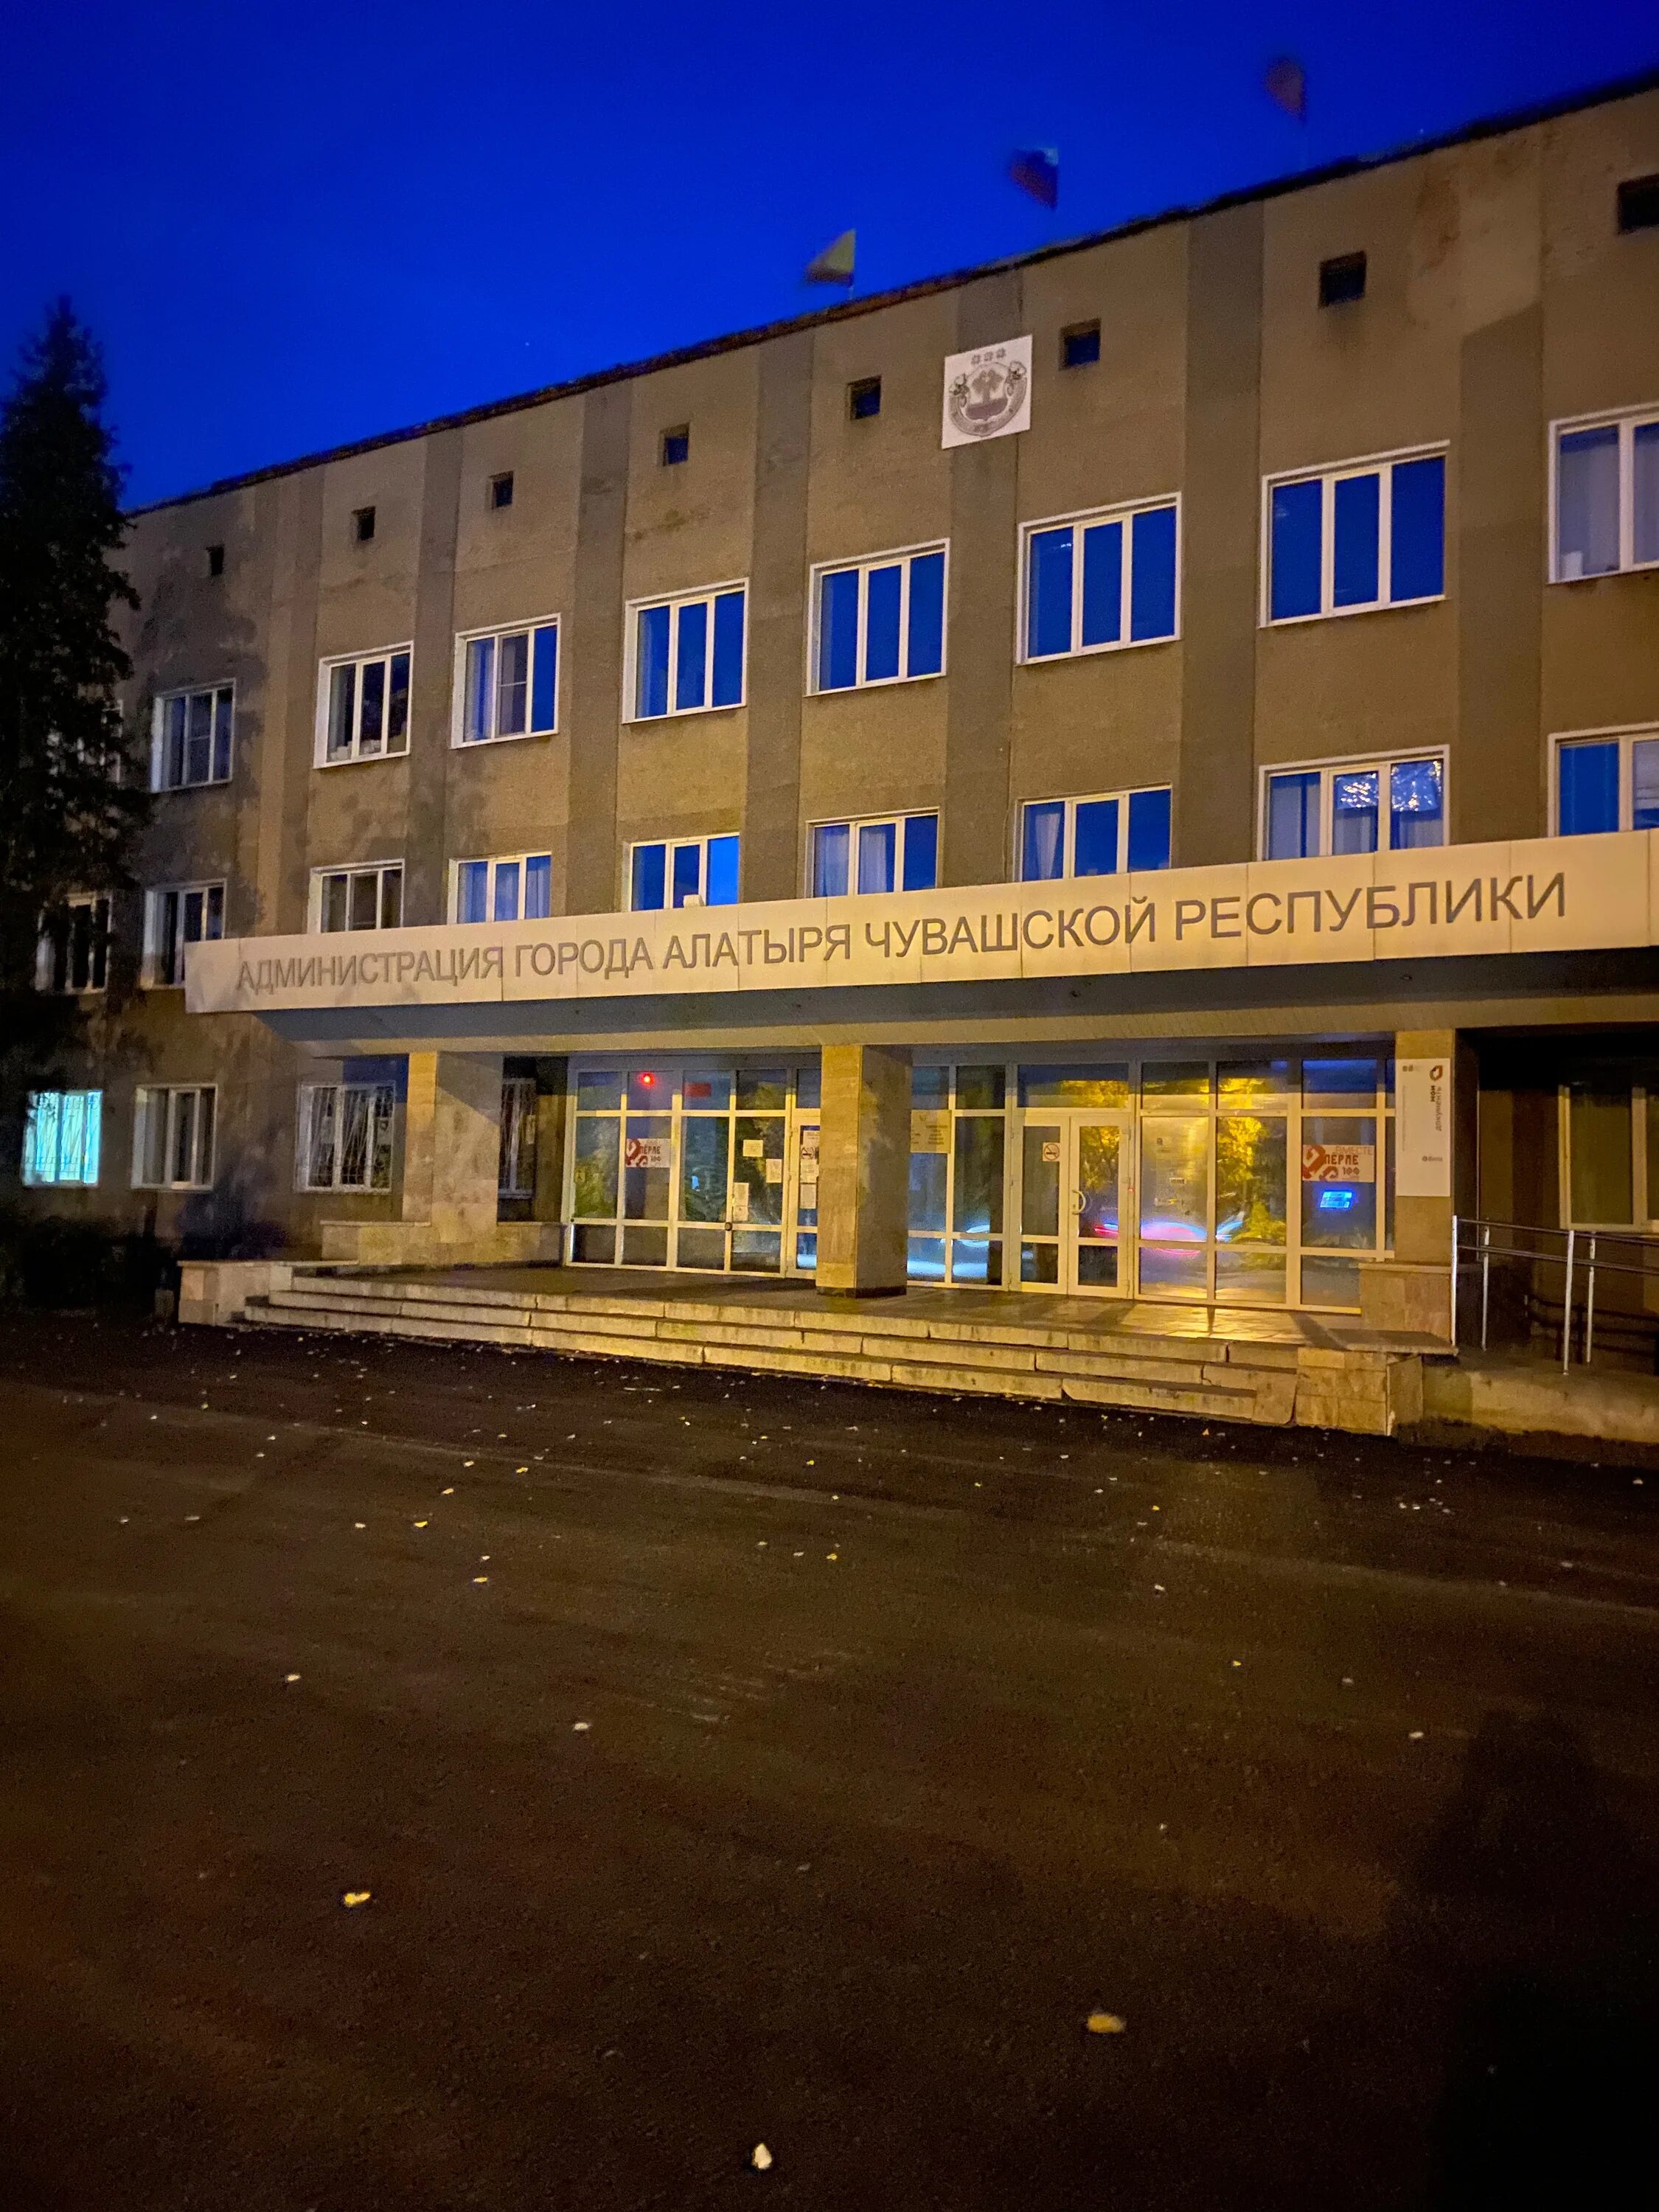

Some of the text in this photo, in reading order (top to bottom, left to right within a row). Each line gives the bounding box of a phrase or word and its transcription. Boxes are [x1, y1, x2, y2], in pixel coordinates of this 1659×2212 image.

[236, 872, 1566, 995] АДМИНИСТРАЦИЯ ГОРОДА АЛАТЫРЯ ЧУВАШСКОЙ РЕСПУБЛИКИ
